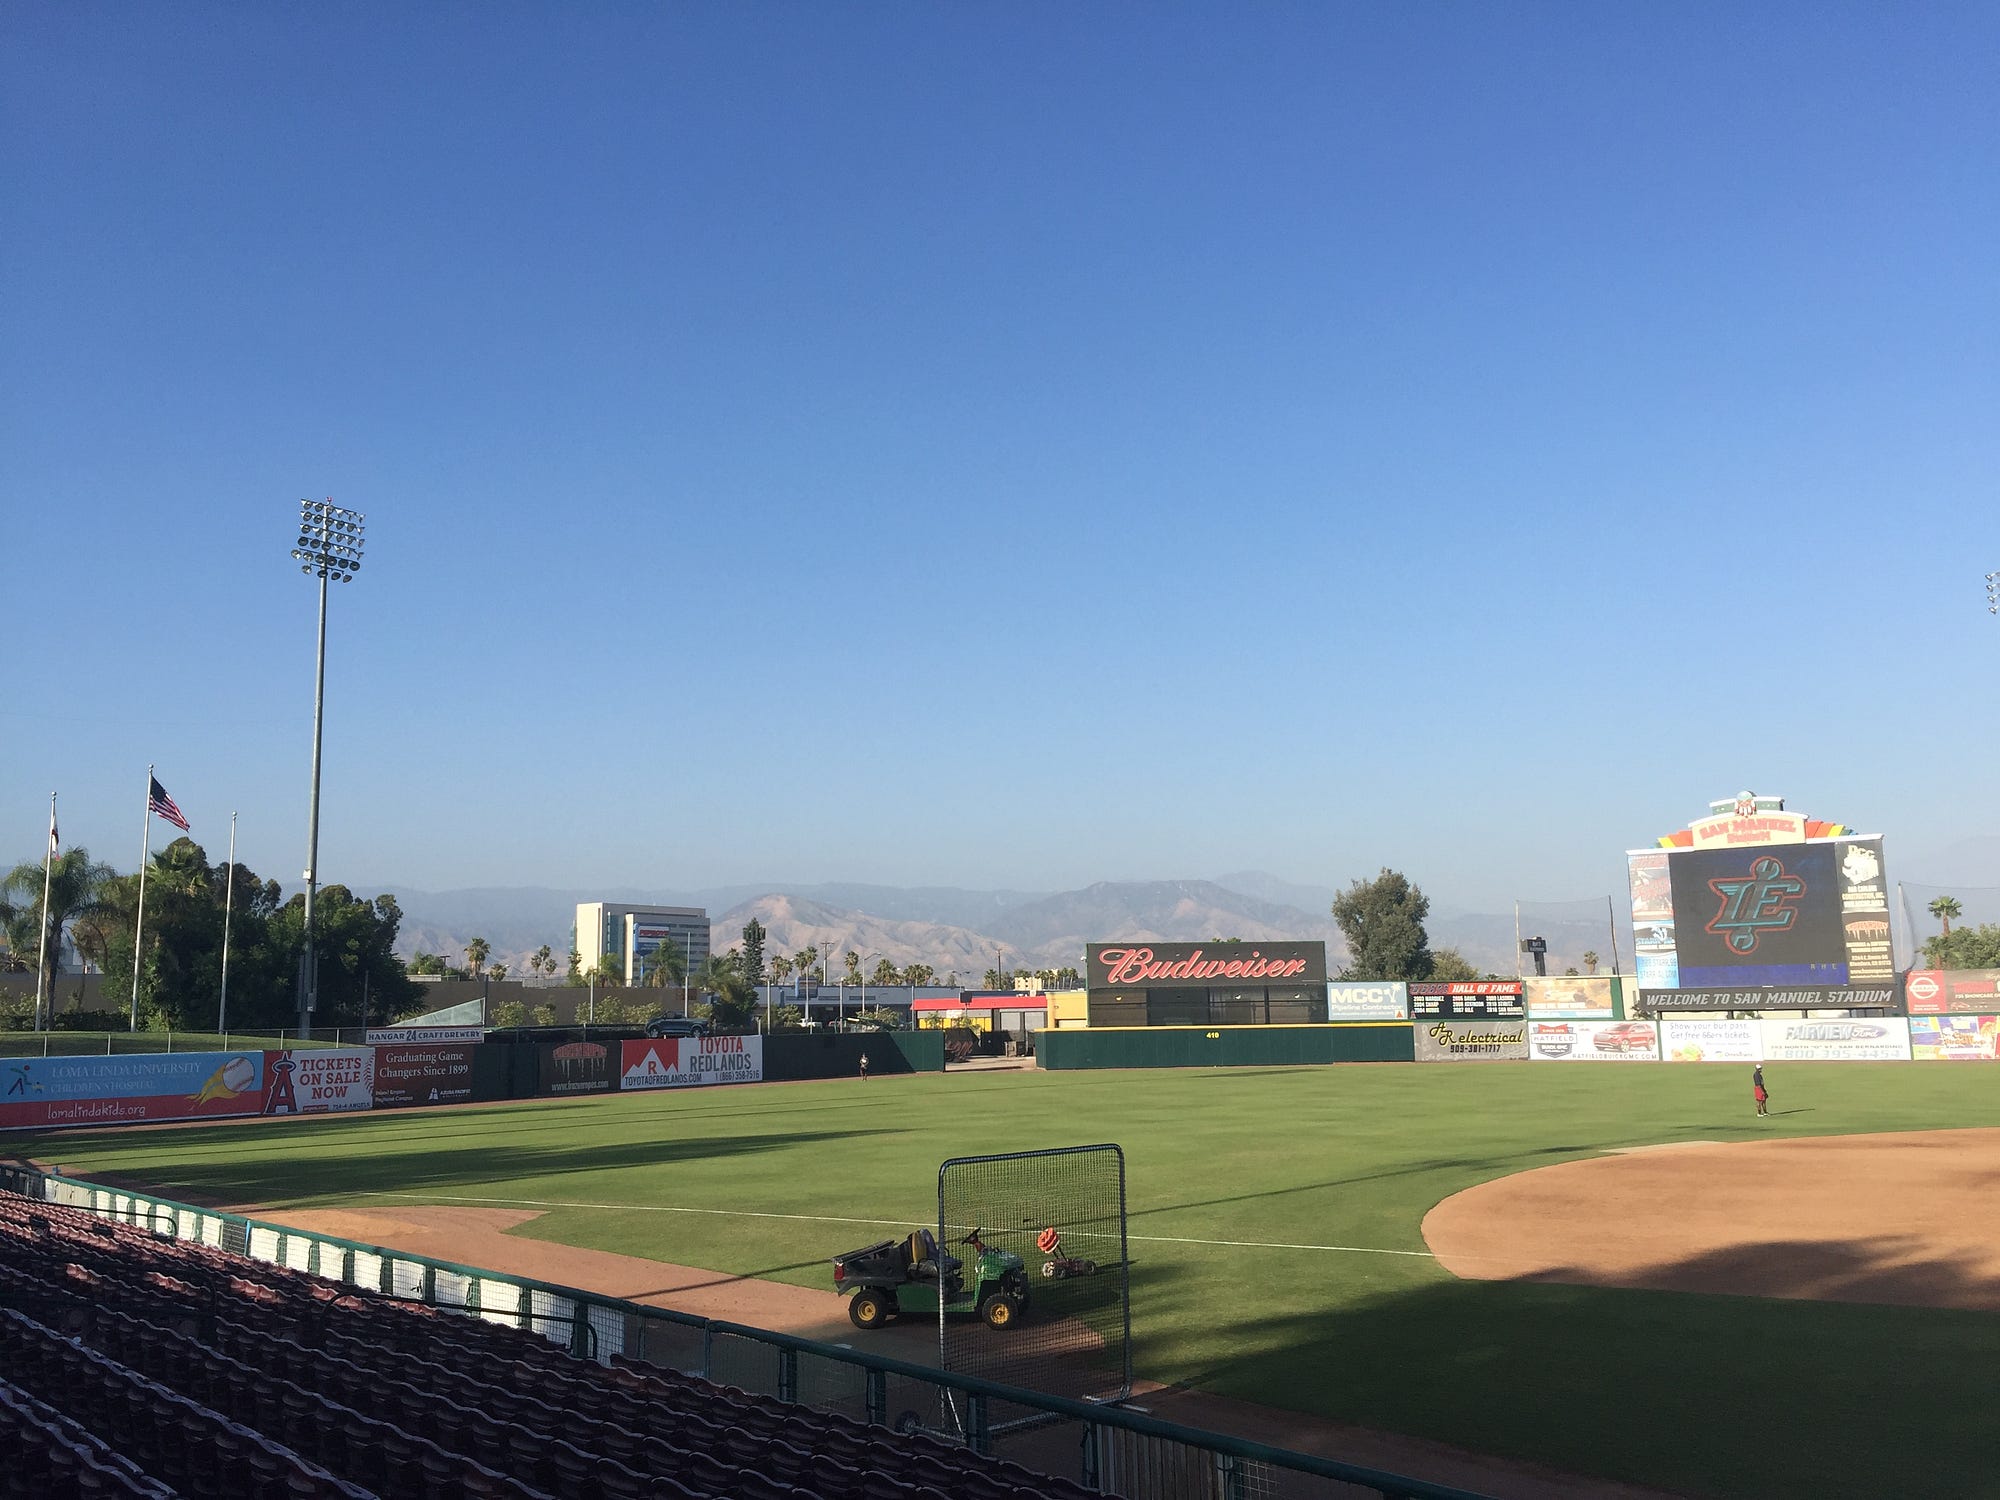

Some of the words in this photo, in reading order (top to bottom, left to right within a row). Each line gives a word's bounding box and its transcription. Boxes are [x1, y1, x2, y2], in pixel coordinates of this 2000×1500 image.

[1099, 947, 1307, 984] Budweiser
[1331, 988, 1383, 1003] MCC
[1452, 984, 1474, 993] HALL
[1477, 984, 1488, 993] OF
[1490, 984, 1516, 993] FAME
[1646, 994, 1710, 1005] WELCOME
[1713, 993, 1730, 1004] TO
[1733, 993, 1762, 1004] SAN
[1765, 990, 1823, 1004] MANUEL
[1827, 990, 1893, 1003] STADIUM
[1670, 1022, 1691, 1030] Show
[1694, 1023, 1710, 1031] your
[1786, 1024, 1851, 1040] FAIRVIEW
[1851, 1027, 1879, 1038] Ford
[368, 1032, 404, 1041] HANGAR
[406, 1030, 417, 1041] 24
[418, 1031, 443, 1039] CRAFT
[444, 1030, 480, 1038] BREWERY
[1206, 1031, 1220, 1039] 410
[1458, 1029, 1524, 1044] electrical
[1684, 1032, 1699, 1040] free
[699, 1036, 743, 1054] TOYOTA
[386, 1052, 437, 1065] Graduating
[438, 1051, 464, 1061] Game
[1773, 1050, 1900, 1059] 1-800-395-4454
[300, 1057, 362, 1071] TICKETS
[648, 1060, 657, 1074] R
[690, 1053, 752, 1072] REDLANDS
[52, 1065, 90, 1078] LOMA
[92, 1063, 130, 1077] LINDA
[132, 1062, 201, 1076] UNIVERSITY
[380, 1067, 421, 1079] Changers
[424, 1065, 446, 1076] Since
[448, 1064, 468, 1074] 1899
[300, 1073, 322, 1086] ON
[326, 1071, 360, 1085] SALE
[625, 1073, 702, 1087] TOYOTAOFREDLANDS.COM
[312, 1086, 348, 1099] NOW
[48, 1101, 146, 1119] lomalindakids.org
